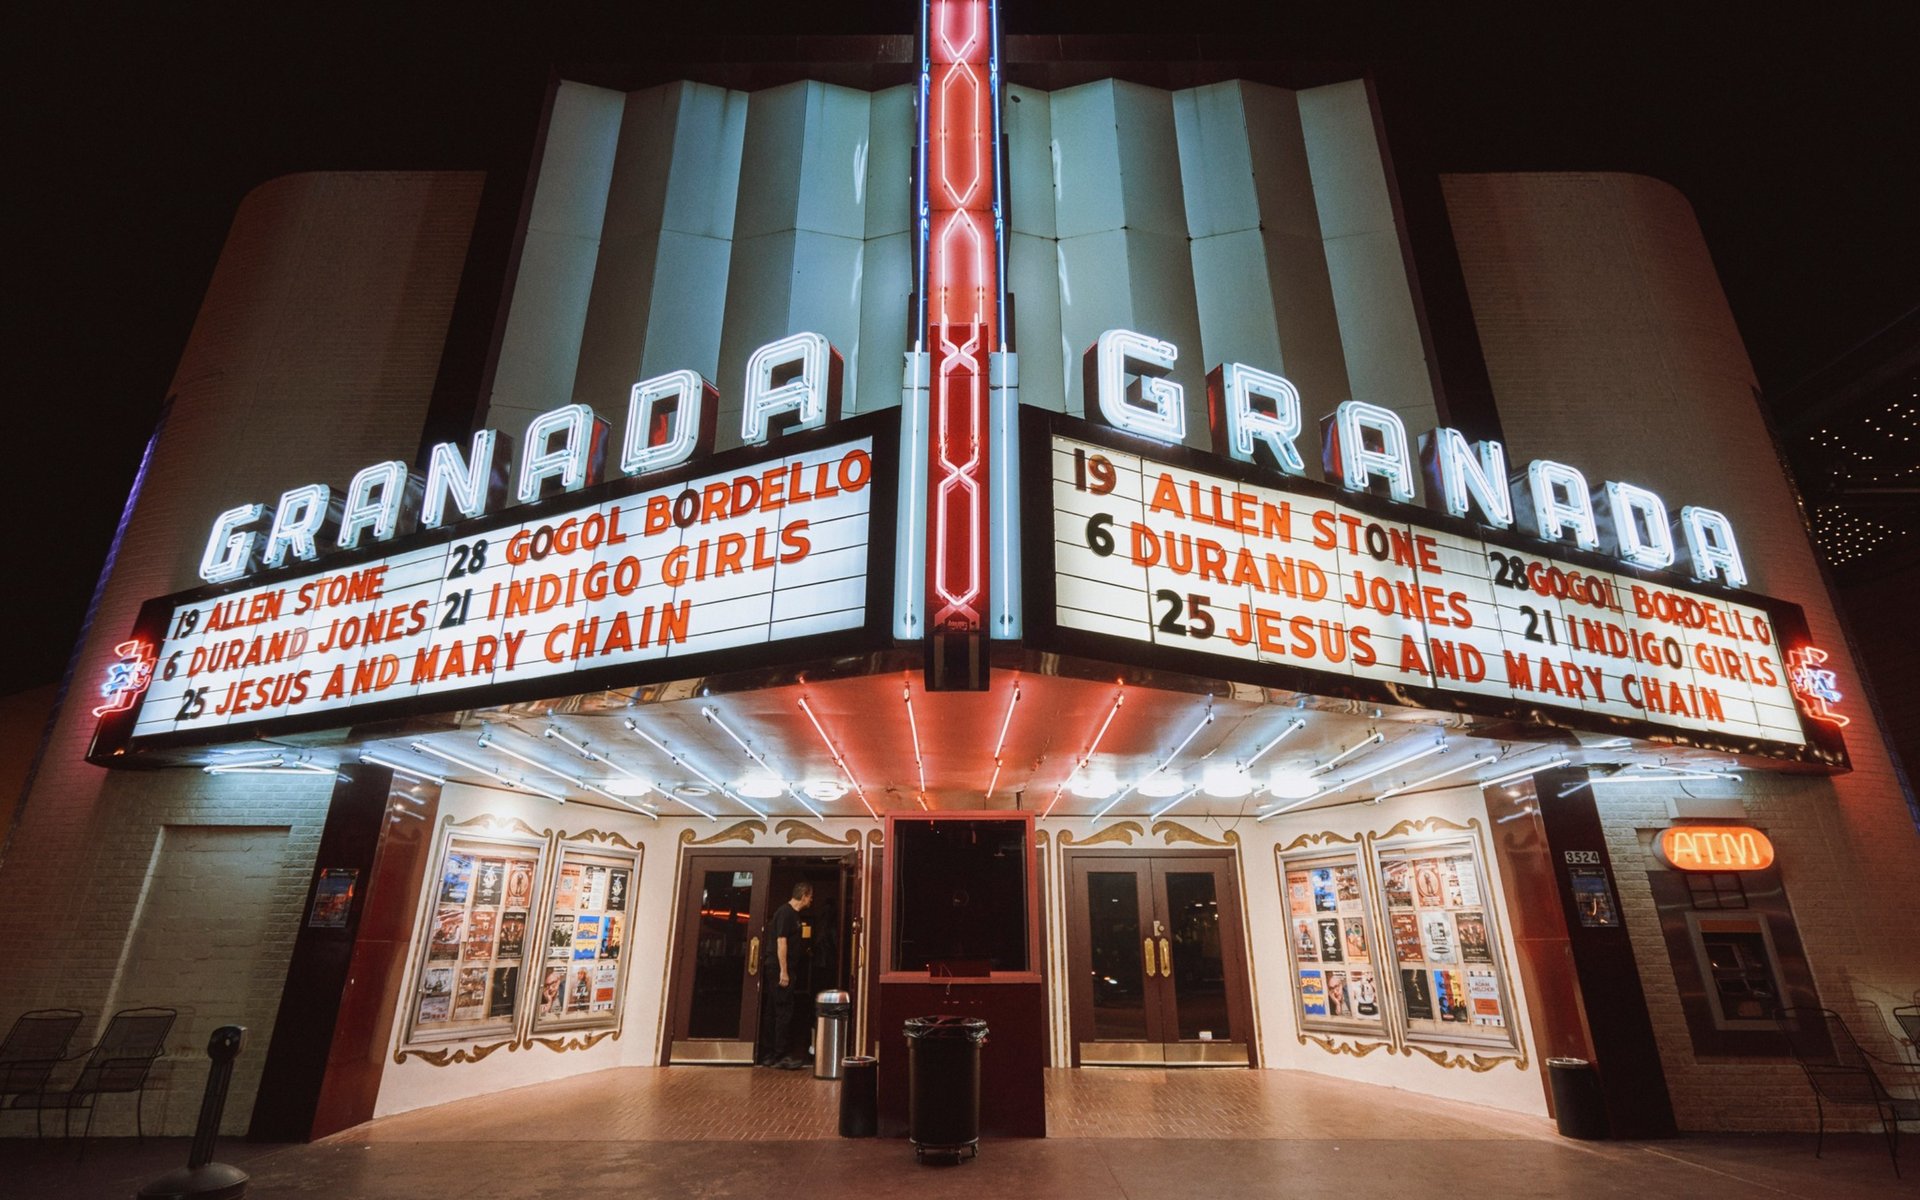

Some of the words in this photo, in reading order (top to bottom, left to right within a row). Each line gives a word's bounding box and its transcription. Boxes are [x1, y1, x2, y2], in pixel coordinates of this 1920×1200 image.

[199, 331, 832, 583] GRANADA
[1097, 328, 1748, 587] GRANADA
[162, 649, 179, 682] 6
[187, 626, 308, 679] DURAND
[317, 600, 429, 655] JONES
[442, 589, 472, 629] 21
[486, 555, 641, 622] INDIGO
[660, 519, 811, 589] GIRLS
[173, 609, 199, 641] 19
[204, 591, 284, 634] ALLEN
[295, 566, 388, 614] STONE
[451, 540, 487, 580] 28
[506, 506, 627, 567] GOGOL
[644, 449, 872, 537] BORDELLO
[1073, 447, 1117, 496] 19
[1149, 472, 1291, 543] ALLEN
[1312, 509, 1443, 577] STONE
[1489, 552, 1529, 592] 28
[1526, 561, 1624, 614] GOGOL
[1630, 584, 1771, 646] BORDELLO
[1086, 512, 1115, 558] 6
[1130, 520, 1329, 603] DURAND
[1344, 570, 1474, 630] JONES
[1519, 605, 1558, 646] 21
[1566, 614, 1683, 670] INDIGO
[1694, 643, 1778, 689] GIRLS
[175, 686, 207, 721] 25
[214, 670, 311, 717] JESUS
[320, 653, 400, 701] AND
[409, 629, 527, 686] MARY
[543, 599, 693, 665] CHAIN
[1155, 589, 1216, 640] 25
[1225, 603, 1377, 668] JESUS
[1399, 634, 1487, 684] AND
[1502, 650, 1607, 704] MARY
[1621, 673, 1726, 725] CHAIN
[1566, 852, 1600, 863] 3524
[1673, 832, 1760, 865] ATM
